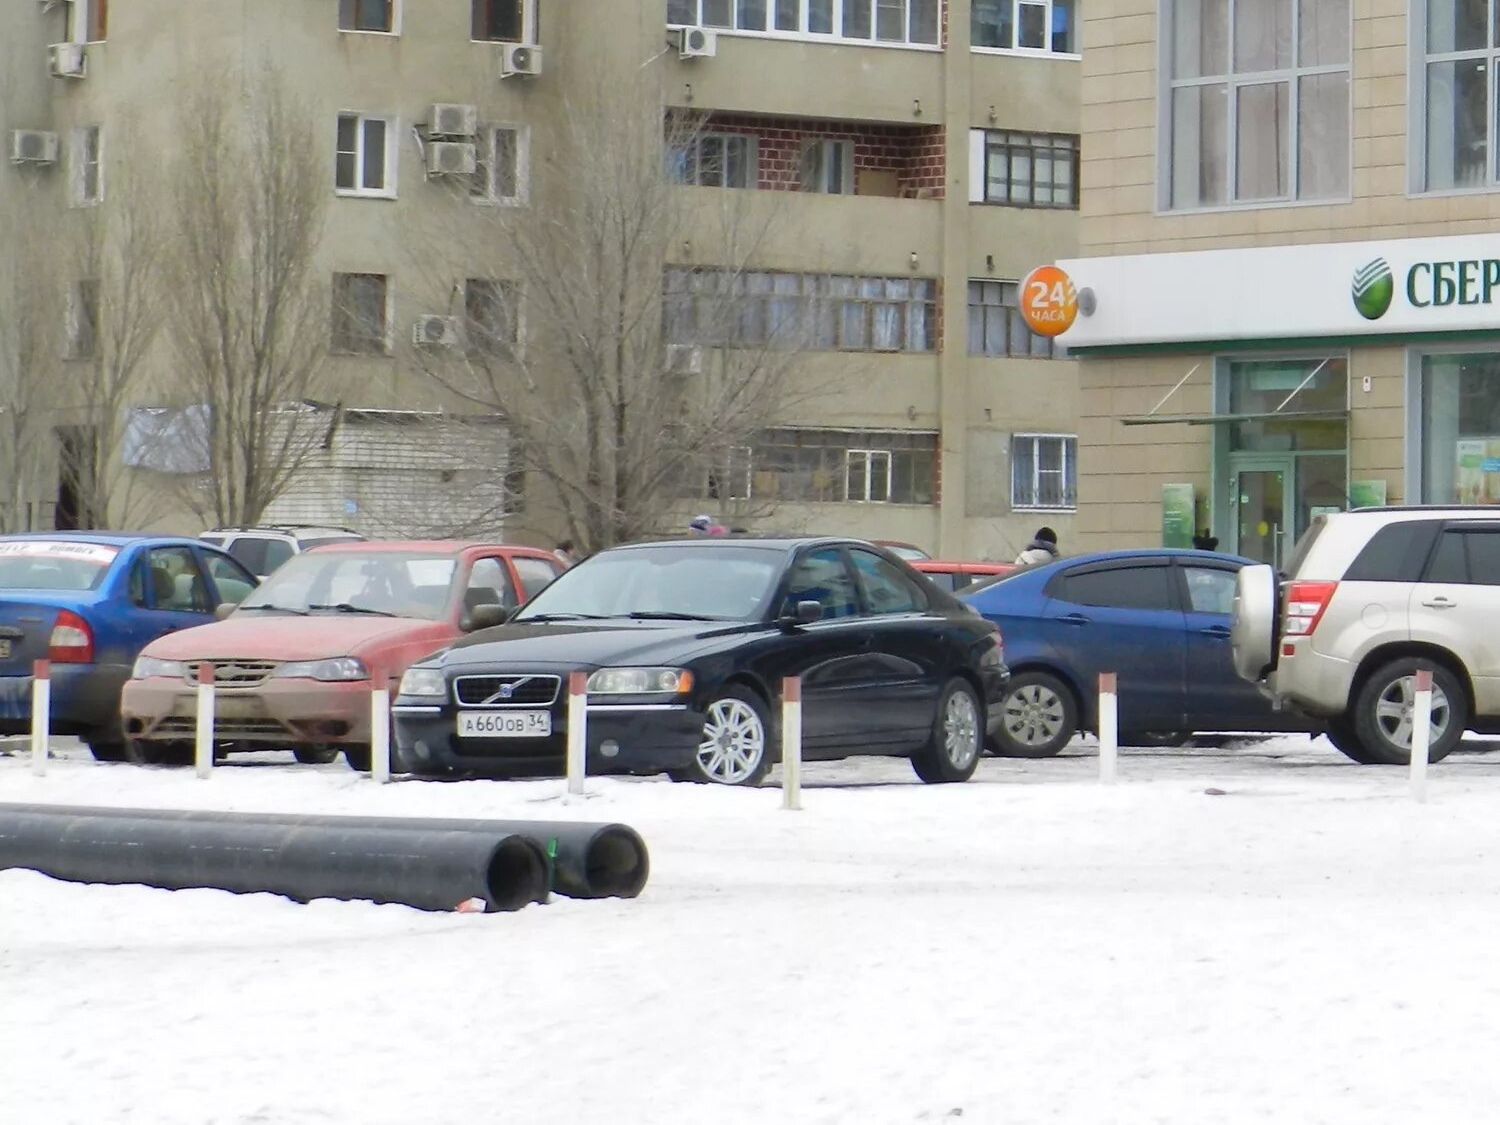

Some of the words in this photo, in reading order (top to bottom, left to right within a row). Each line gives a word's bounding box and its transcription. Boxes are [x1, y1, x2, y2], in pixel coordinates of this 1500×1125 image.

[1030, 281, 1066, 308] 24
[1031, 309, 1066, 322] ЧАСА
[528, 714, 544, 727] 34
